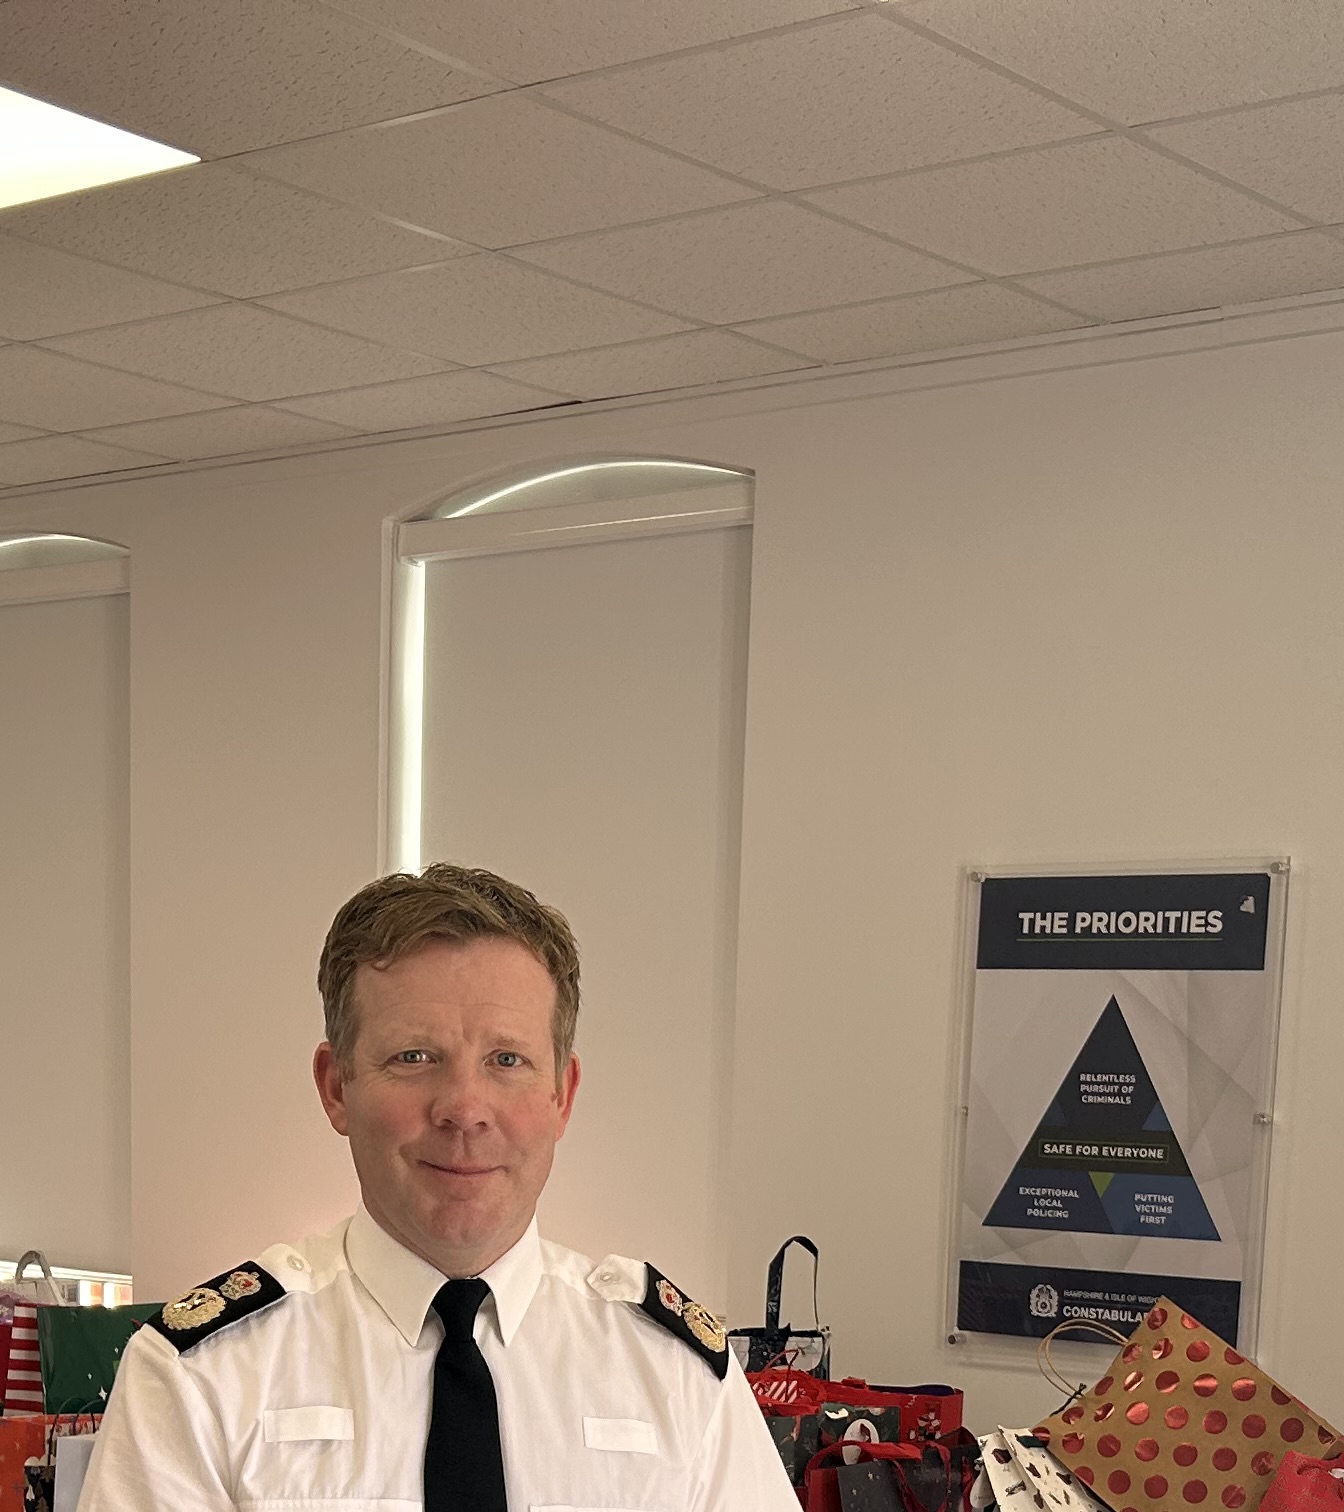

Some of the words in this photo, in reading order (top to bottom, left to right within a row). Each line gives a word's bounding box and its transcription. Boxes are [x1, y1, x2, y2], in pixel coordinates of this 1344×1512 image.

[1019, 912, 1068, 934] THE
[1074, 910, 1223, 934] PRIORITIES
[1080, 1074, 1136, 1083] RELENTLESS
[1080, 1084, 1120, 1093] PURSUIT
[1121, 1085, 1134, 1093] OF
[1081, 1095, 1132, 1104] CRIMINALS
[1043, 1143, 1072, 1155] SAFE
[1076, 1145, 1099, 1156] FOR
[1102, 1146, 1164, 1159] EVERYONE
[1034, 1198, 1063, 1208] LOCAL
